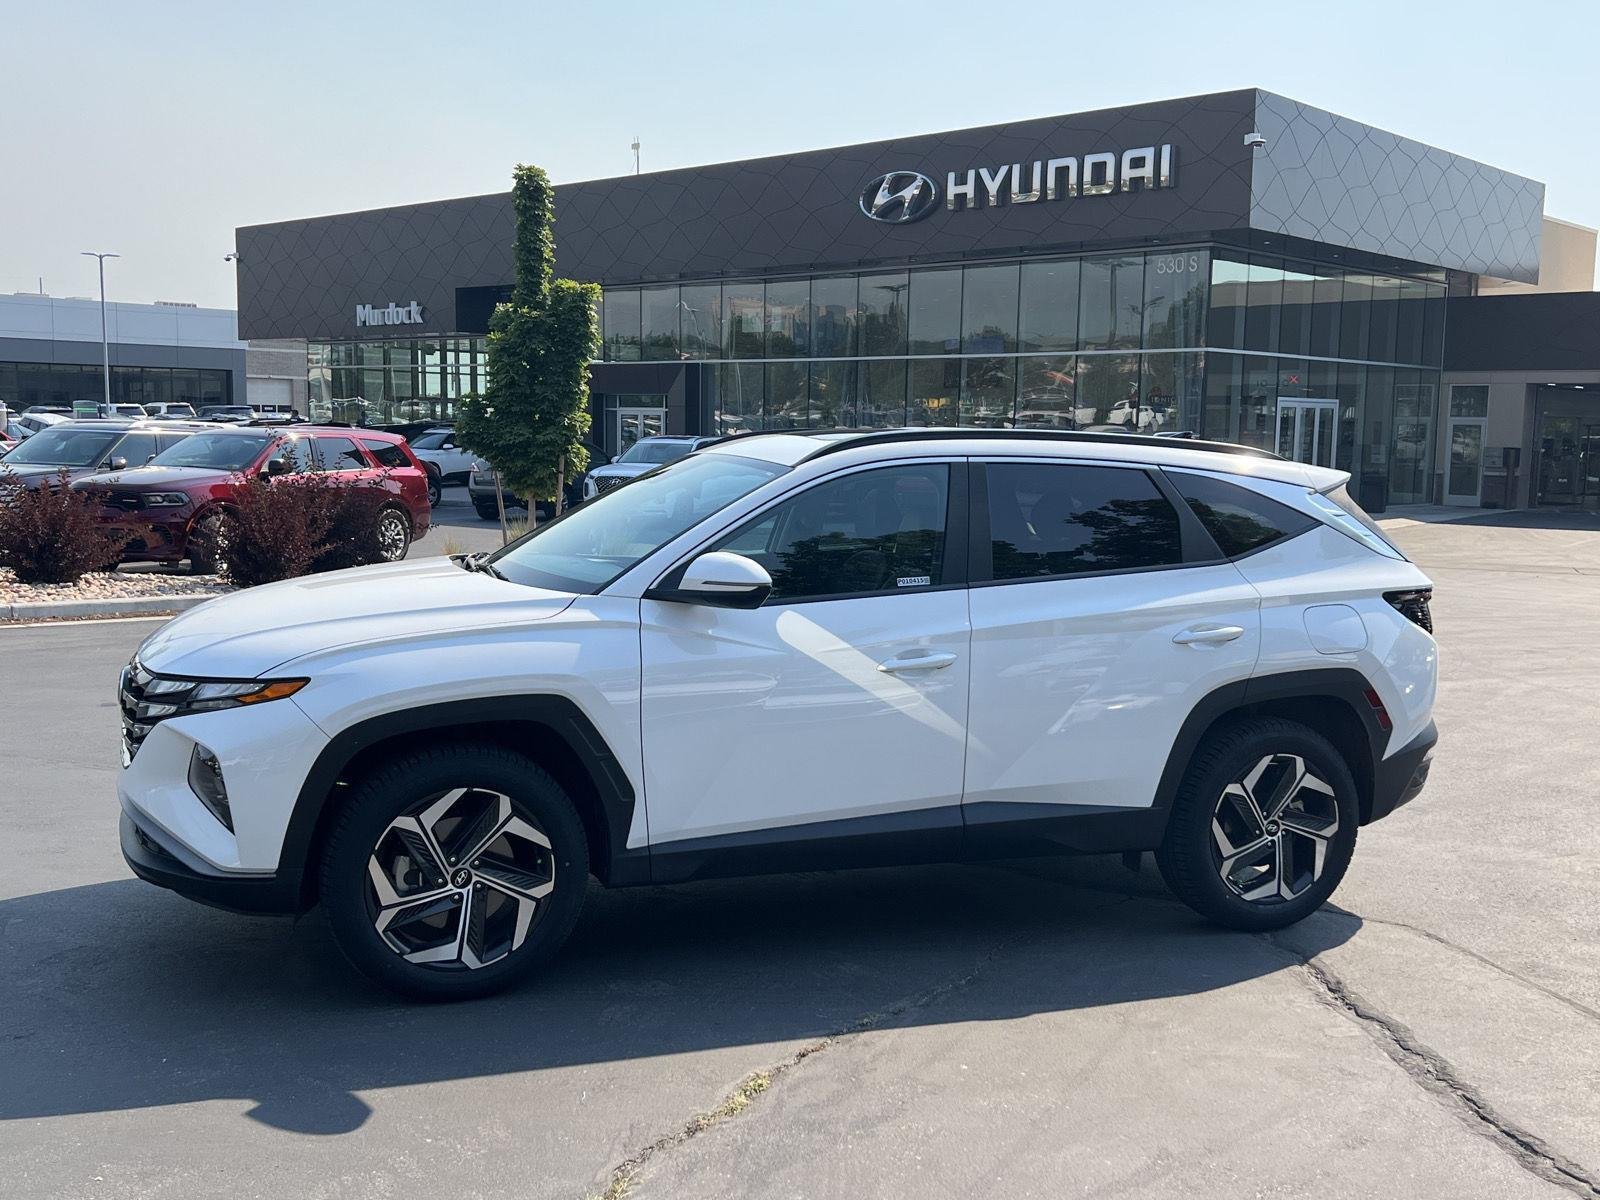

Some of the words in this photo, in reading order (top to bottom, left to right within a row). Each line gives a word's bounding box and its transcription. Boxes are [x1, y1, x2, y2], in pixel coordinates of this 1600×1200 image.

[947, 144, 1173, 210] HYUNDAI
[1157, 257, 1184, 274] 530
[1189, 256, 1198, 272] S
[356, 301, 423, 326] Murdock
